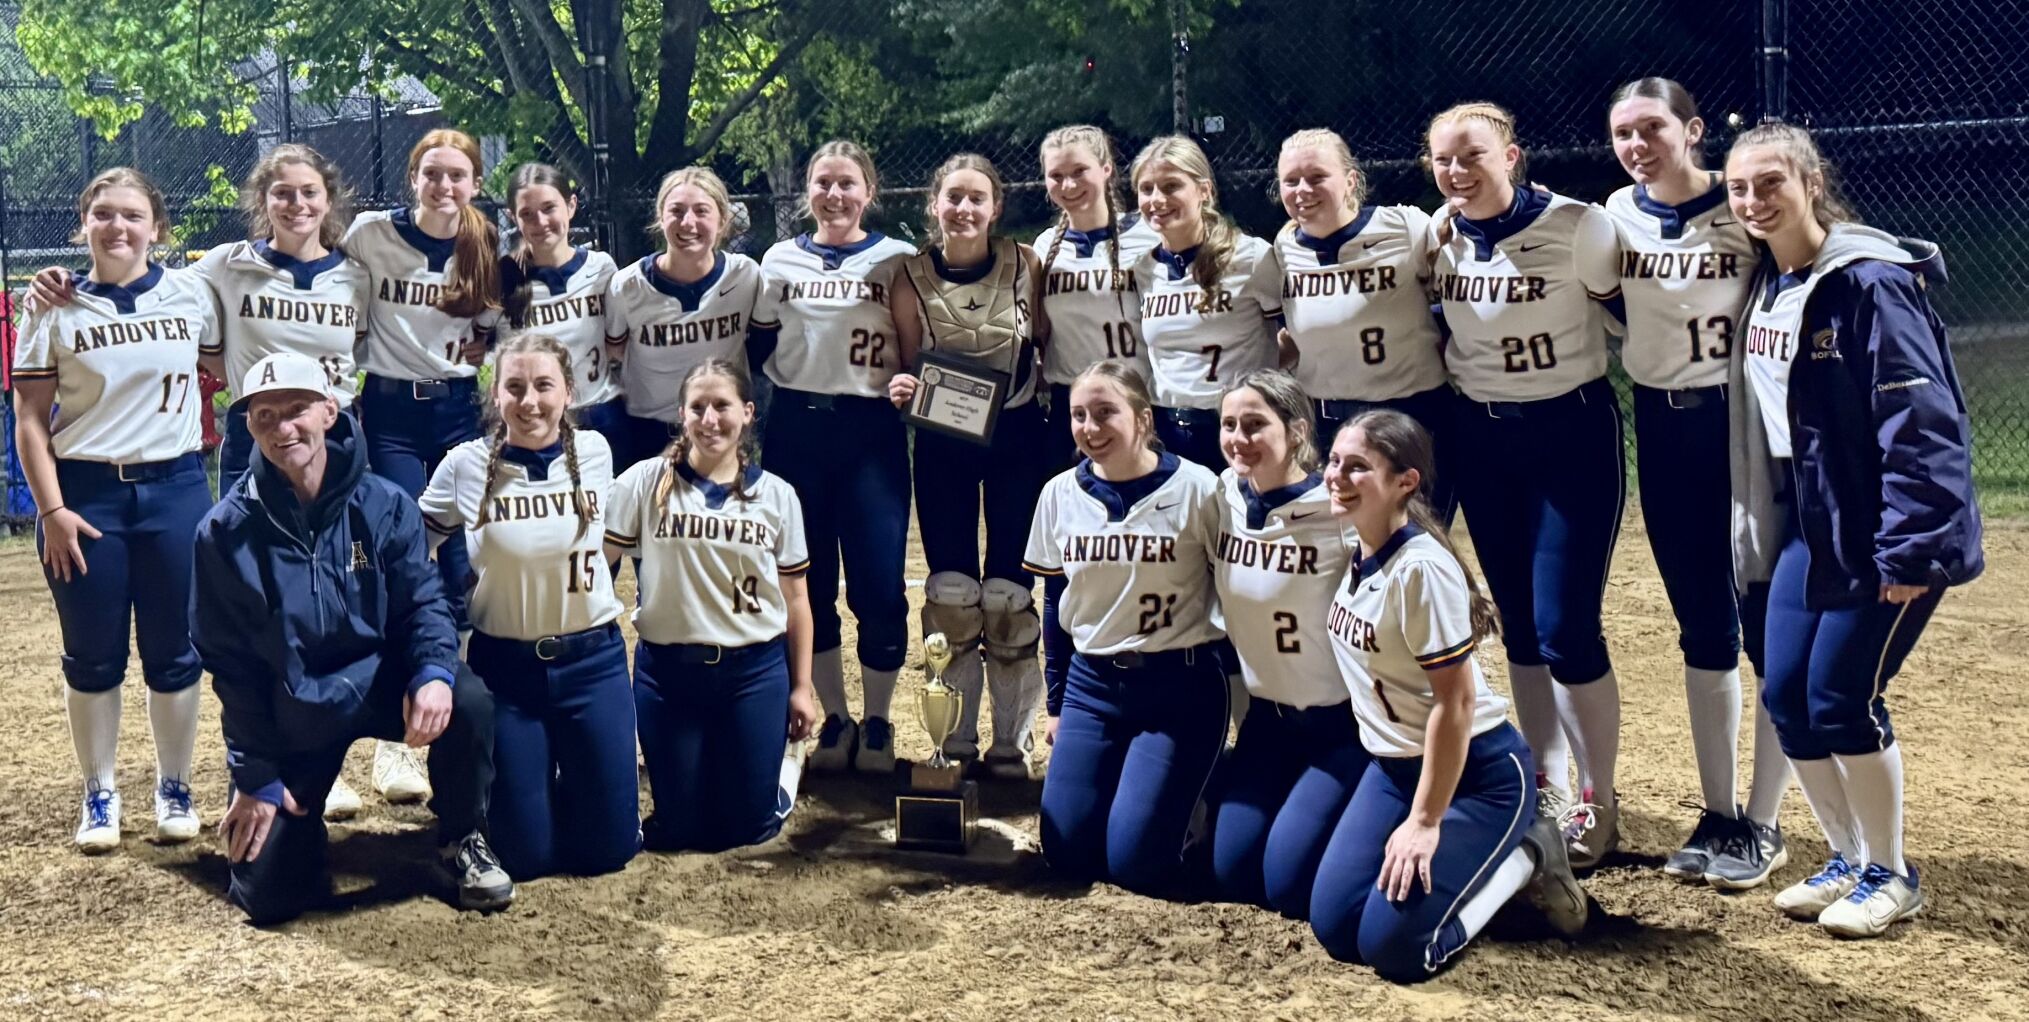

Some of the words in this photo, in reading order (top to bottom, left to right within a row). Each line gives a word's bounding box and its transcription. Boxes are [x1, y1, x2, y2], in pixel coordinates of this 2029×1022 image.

[1282, 265, 1396, 298] ANDOVER
[1620, 251, 1738, 279] NDOVER
[378, 277, 449, 307] ANDO
[525, 294, 606, 327] NDOVE
[779, 280, 884, 304] ANDOVER
[239, 294, 356, 328] ANDOVER
[639, 312, 741, 347] ANDOVER
[74, 317, 191, 354] ANDOVER
[850, 328, 885, 369] 22
[1103, 322, 1137, 358] 10
[1360, 327, 1386, 365] 8
[1501, 332, 1557, 373] 20
[1687, 315, 1733, 362] 13
[260, 361, 277, 386] A
[586, 345, 600, 382] 3
[1201, 345, 1222, 382] 7
[158, 373, 190, 414] 17
[483, 490, 600, 522] NDOVR
[655, 513, 768, 546] ANDOVER
[1064, 534, 1177, 562] ANDOVER
[1217, 531, 1319, 574] NDOVER
[567, 550, 598, 593] 15
[732, 575, 762, 614] 19
[1138, 594, 1177, 634] 21
[1273, 611, 1301, 654] 2
[1328, 601, 1381, 653] DOVER
[1374, 679, 1400, 722] 1
